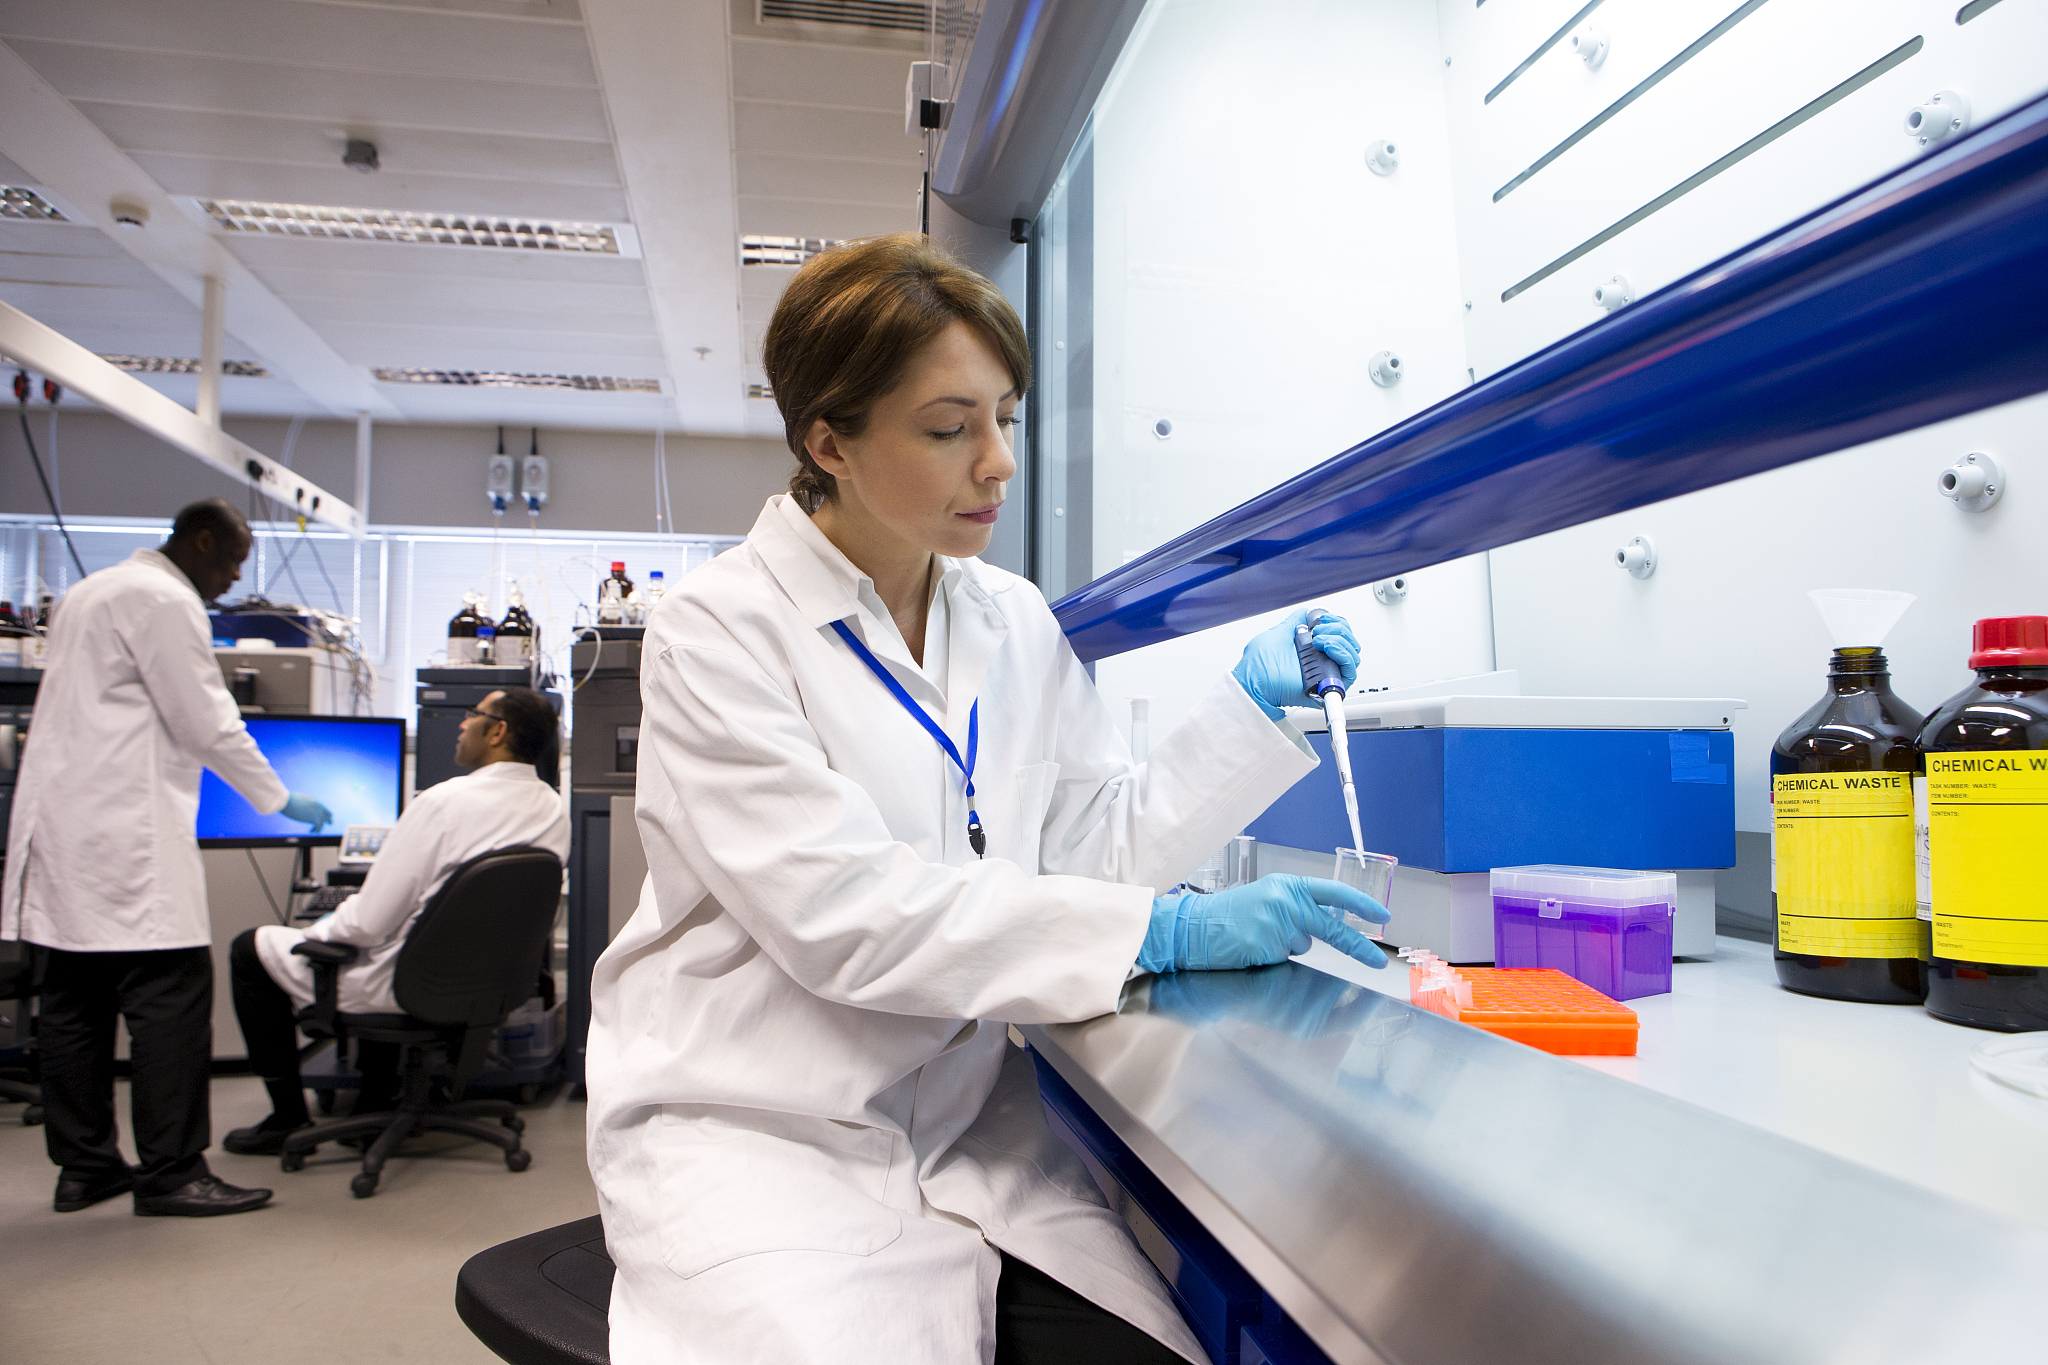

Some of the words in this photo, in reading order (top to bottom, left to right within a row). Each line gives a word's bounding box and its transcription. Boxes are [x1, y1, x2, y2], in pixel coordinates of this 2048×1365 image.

[1932, 758, 2022, 772] CHEMICAL
[2029, 758, 2048, 771] W
[1777, 778, 1840, 791] CHEMICAL
[1844, 777, 1901, 789] WASTE
